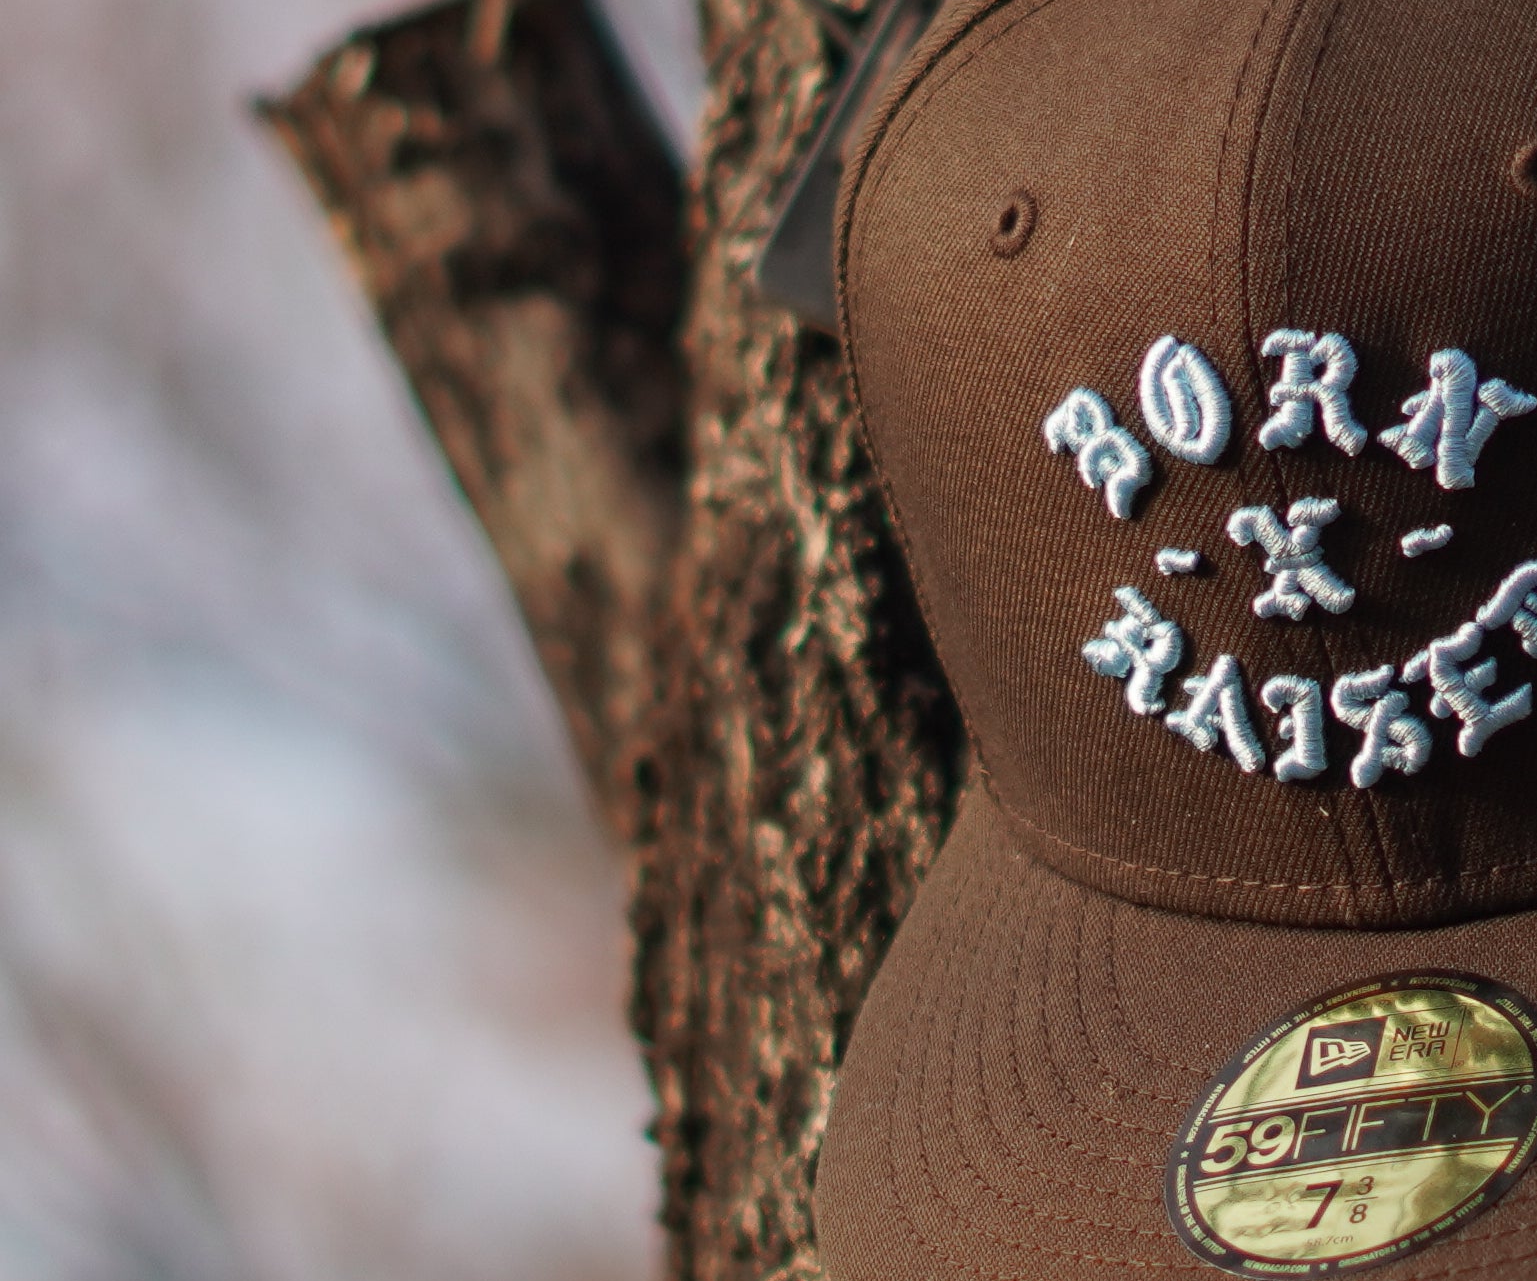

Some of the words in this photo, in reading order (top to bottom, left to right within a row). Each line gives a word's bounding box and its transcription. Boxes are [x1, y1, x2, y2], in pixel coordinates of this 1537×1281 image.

[1392, 1021, 1451, 1043] NEW
[1389, 1040, 1446, 1061] ERA
[1305, 1179, 1344, 1229] 7
